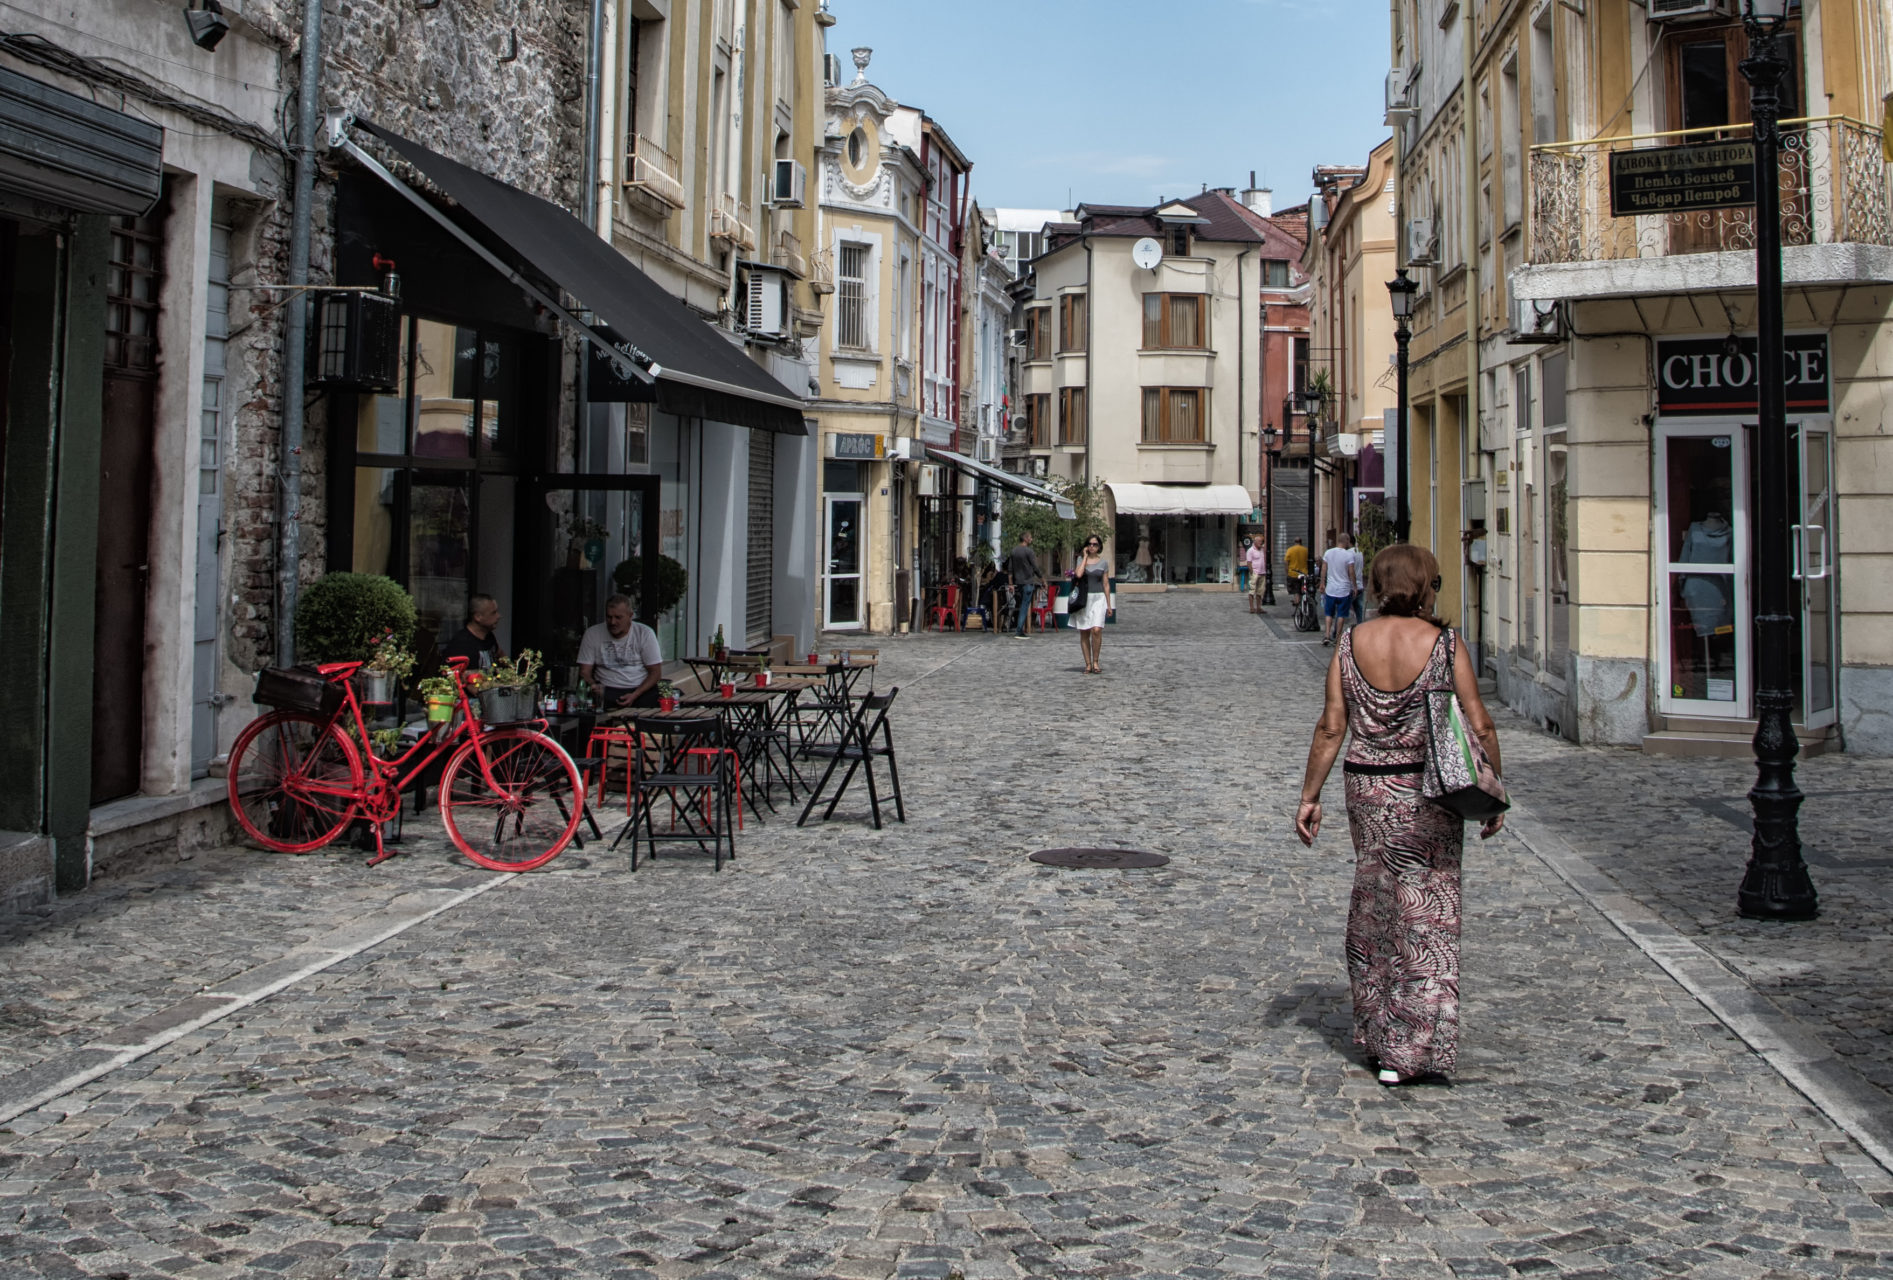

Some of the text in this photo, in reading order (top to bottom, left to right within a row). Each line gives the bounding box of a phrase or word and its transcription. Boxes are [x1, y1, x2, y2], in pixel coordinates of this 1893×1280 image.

[1616, 148, 1753, 170] АДВОКАТСКА КАНТОРА
[1635, 174, 1682, 188] Петко
[1631, 185, 1741, 207] Чавдар Петров
